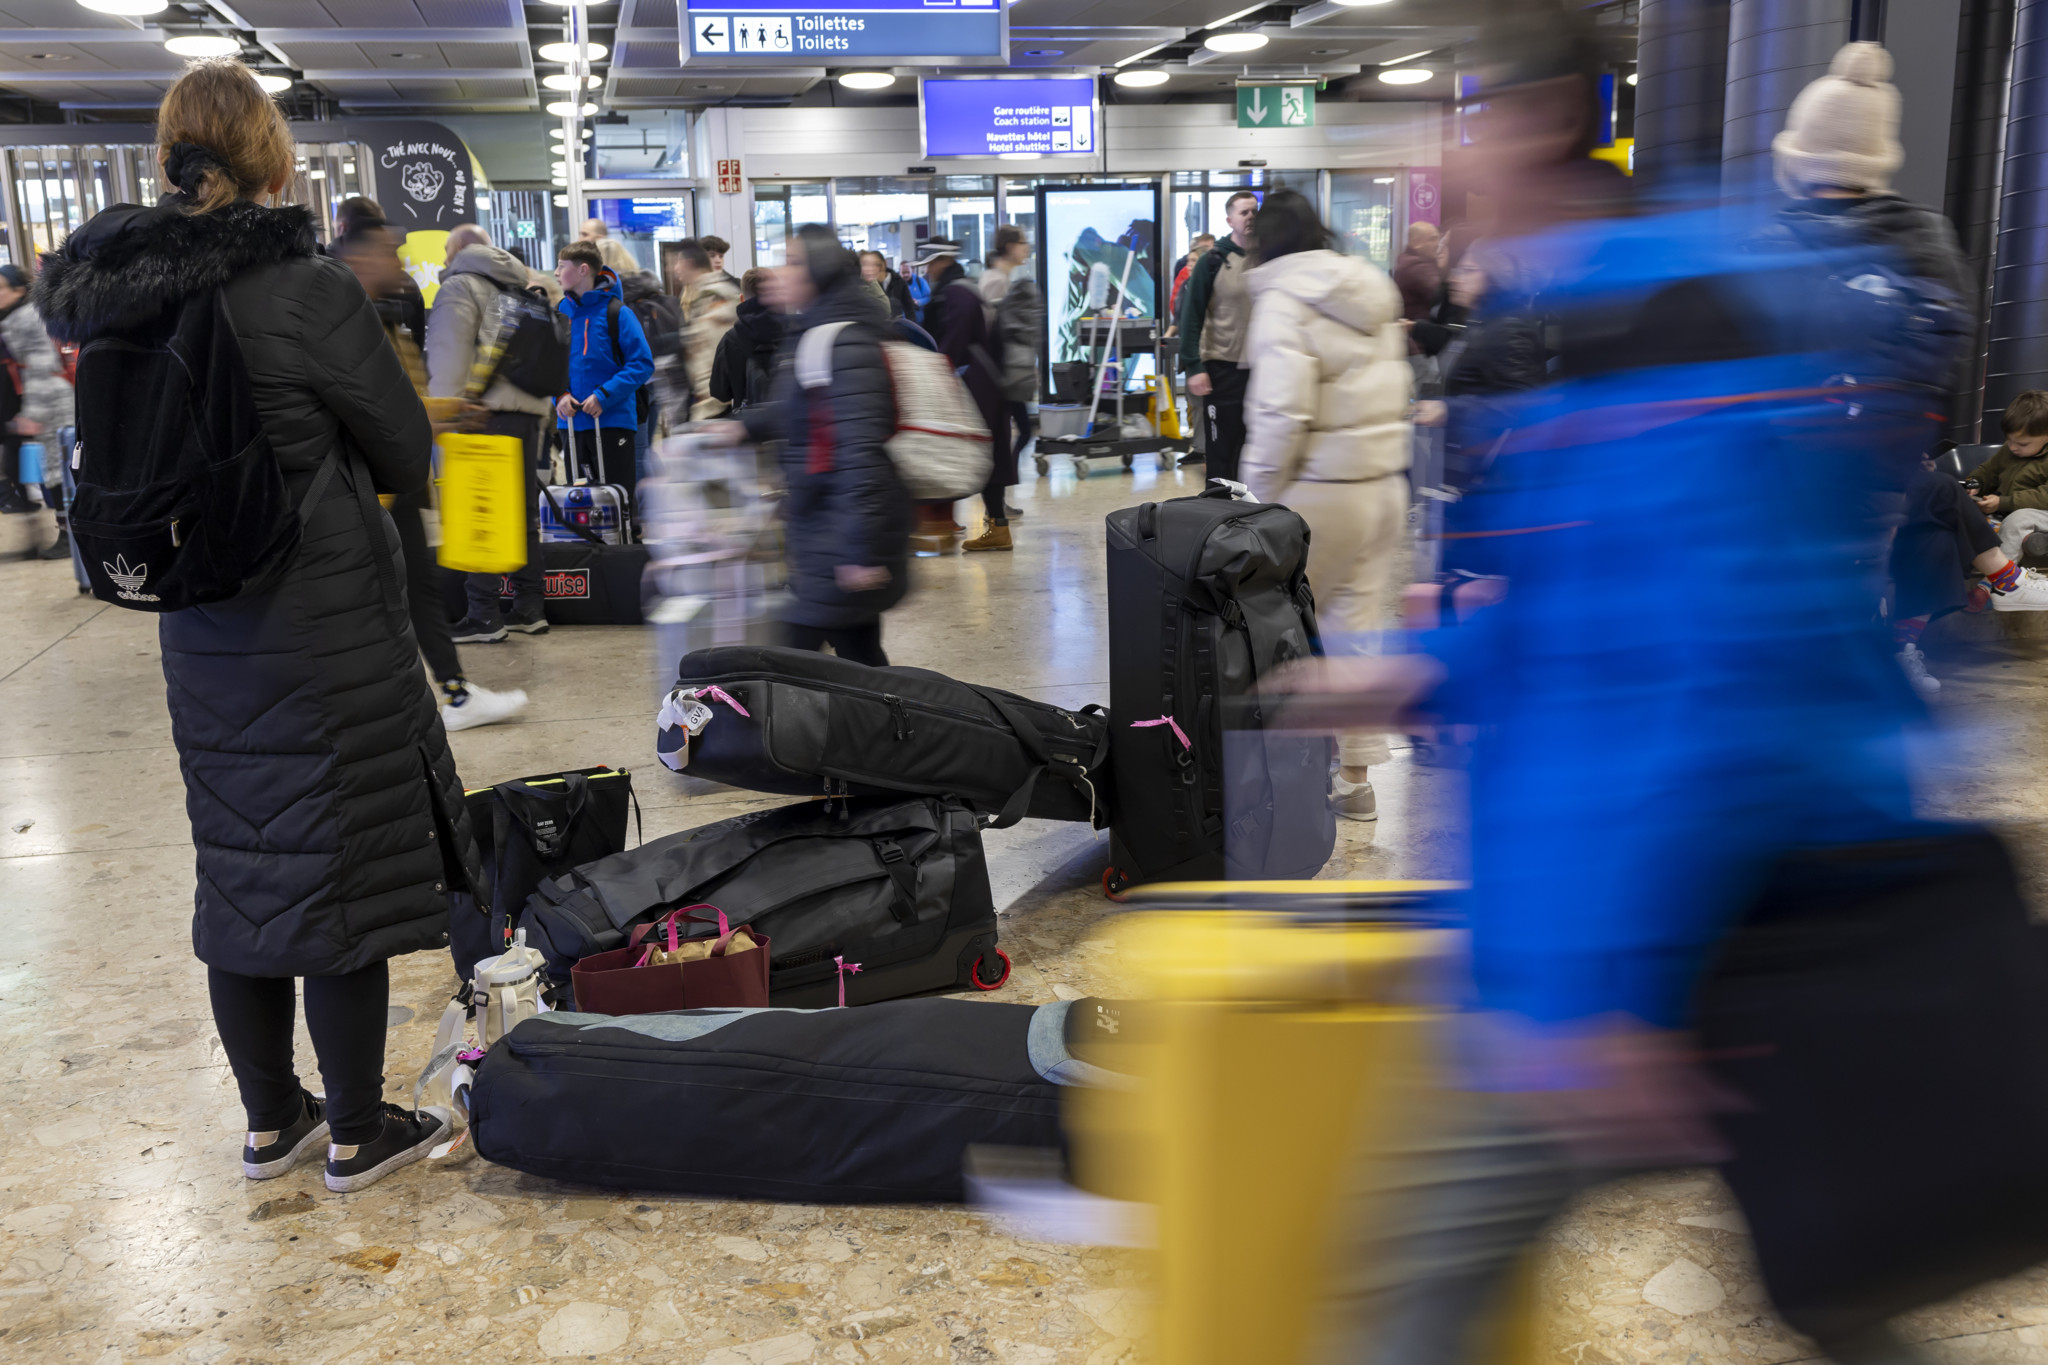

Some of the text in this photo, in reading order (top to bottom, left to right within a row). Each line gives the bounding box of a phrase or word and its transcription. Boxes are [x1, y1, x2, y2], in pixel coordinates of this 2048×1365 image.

[795, 15, 865, 31] Toilettes
[796, 34, 849, 50] Toilets
[993, 105, 1050, 116] Gare routière
[993, 116, 1050, 126] Coach station
[986, 131, 1050, 142] Navettes hôtel
[407, 142, 430, 156] AVEC
[989, 142, 1051, 152] Hotel shuttles
[690, 706, 704, 725] GVA
